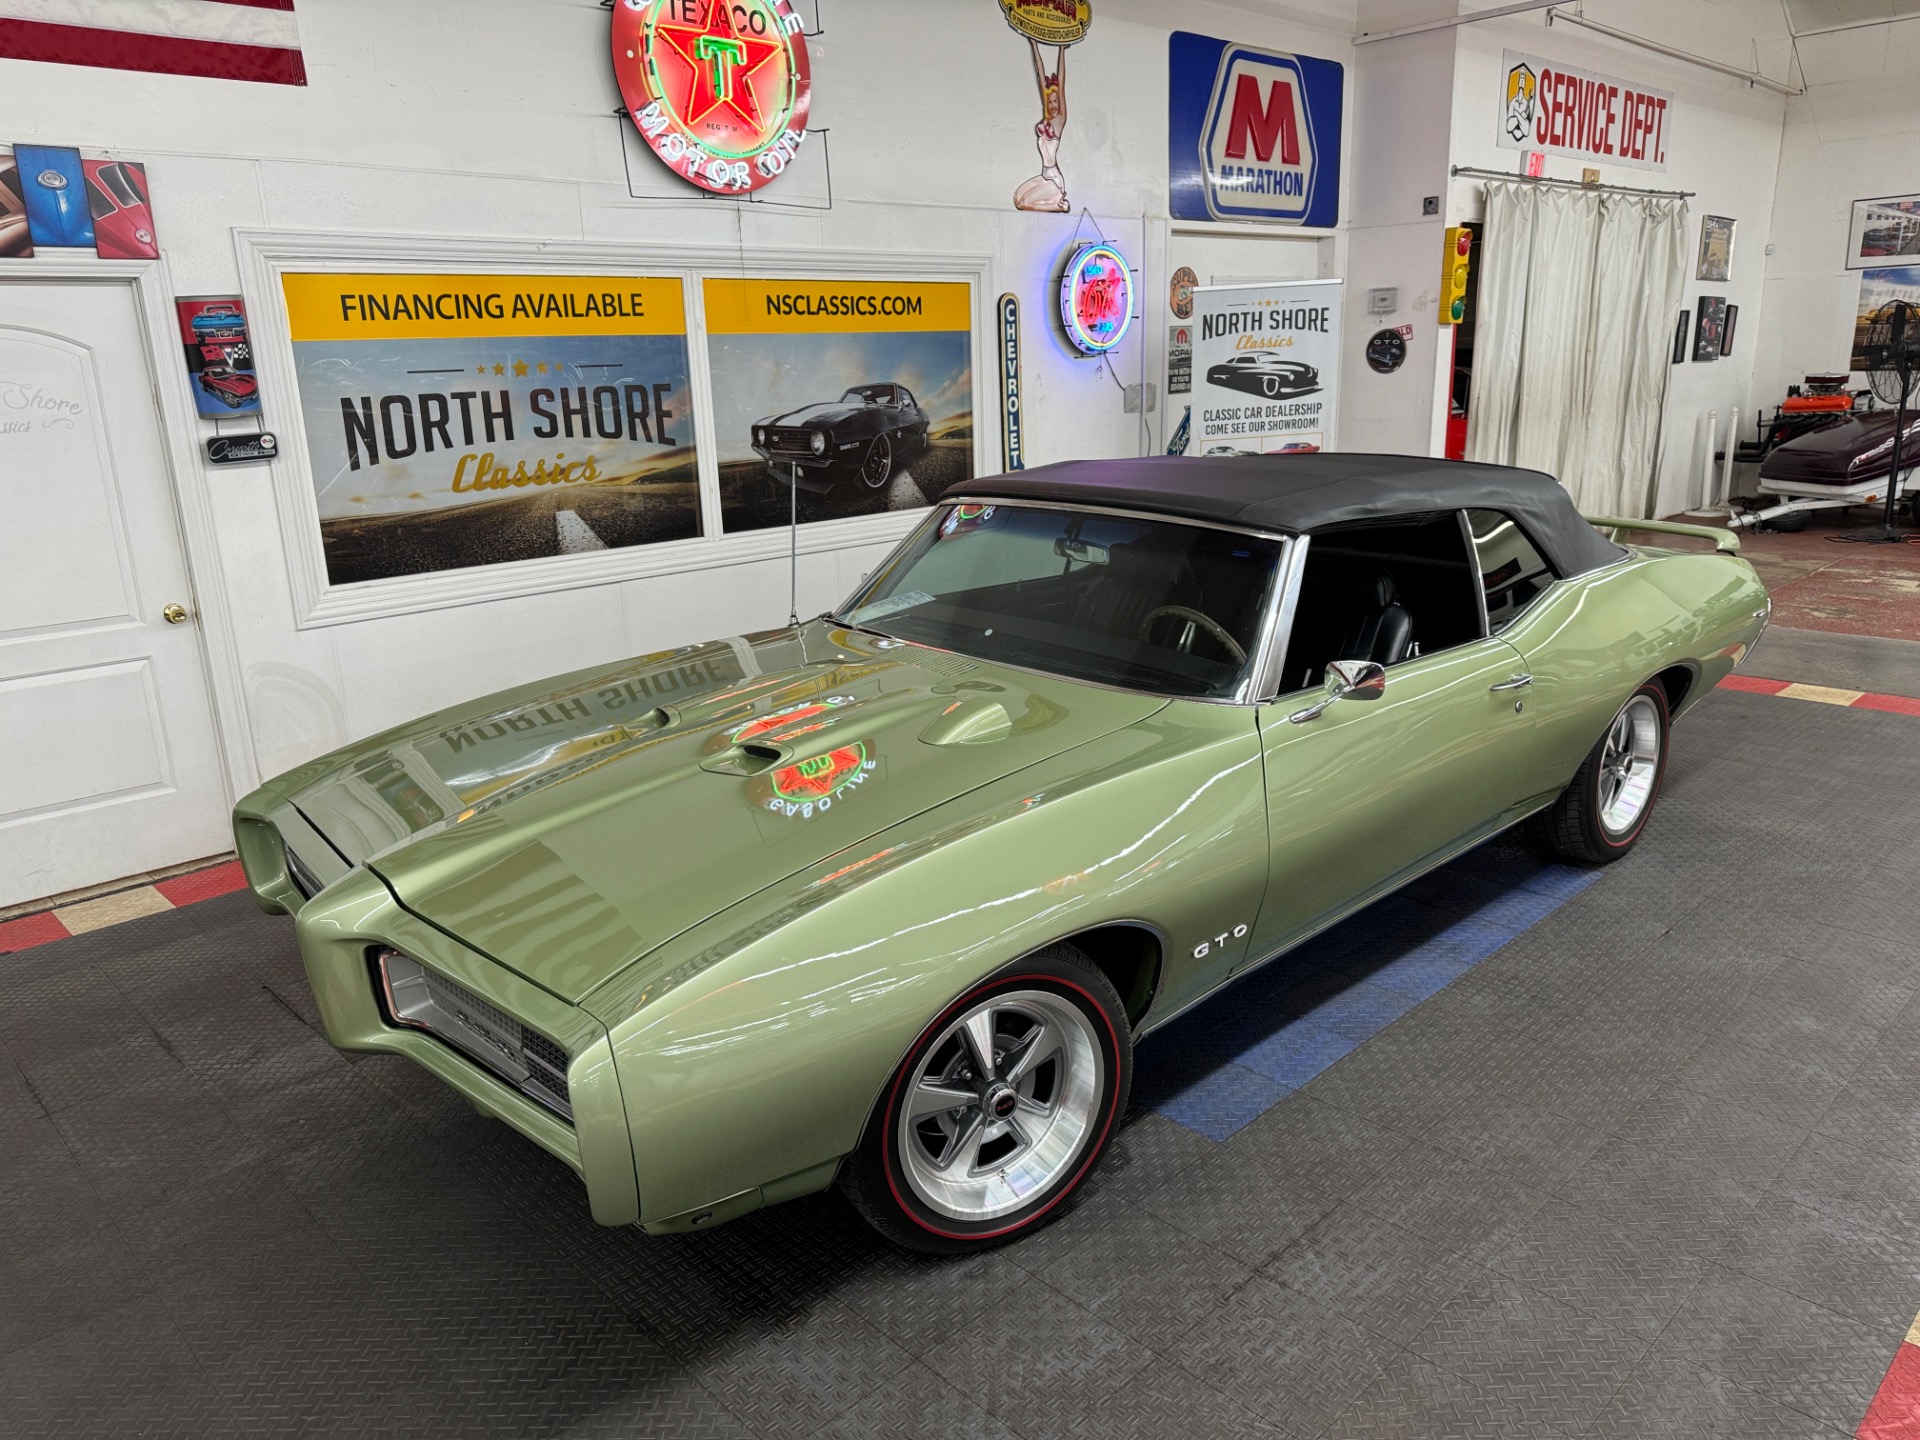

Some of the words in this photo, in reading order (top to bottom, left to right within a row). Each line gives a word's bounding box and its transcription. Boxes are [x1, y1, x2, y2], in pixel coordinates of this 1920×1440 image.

[667, 0, 767, 35] TEXACO
[1224, 73, 1300, 166] M
[1536, 68, 1618, 155] SERVICE
[1619, 90, 1667, 164] DEPT.
[635, 102, 752, 190] MOTOR
[755, 129, 806, 179] OIL
[1219, 164, 1304, 197] MARATHON
[1529, 152, 1545, 177] EXIT
[340, 293, 506, 322] FINANCING
[511, 293, 645, 319] AVAILABLE
[766, 294, 922, 316] NSCLASSICS.COM
[1202, 311, 1263, 341] NORTH
[1269, 307, 1330, 333] SHORE
[1235, 334, 1294, 350] Classics
[3, 383, 83, 415] Shore
[1006, 304, 1019, 467] CHEVROLET
[340, 390, 515, 472] NORTH
[530, 383, 677, 447] SHORE
[1203, 408, 1241, 422] CLASSIC
[1244, 406, 1263, 419] CAR
[1265, 402, 1323, 418] DEALERSHIP
[1205, 422, 1229, 436] COME
[1231, 421, 1246, 434] SEE
[1248, 421, 1266, 432] OUR
[1267, 417, 1319, 431] SHOWROOM!
[209, 439, 261, 460] Corvette
[451, 452, 603, 494] Classics
[1193, 923, 1248, 959] GTO
